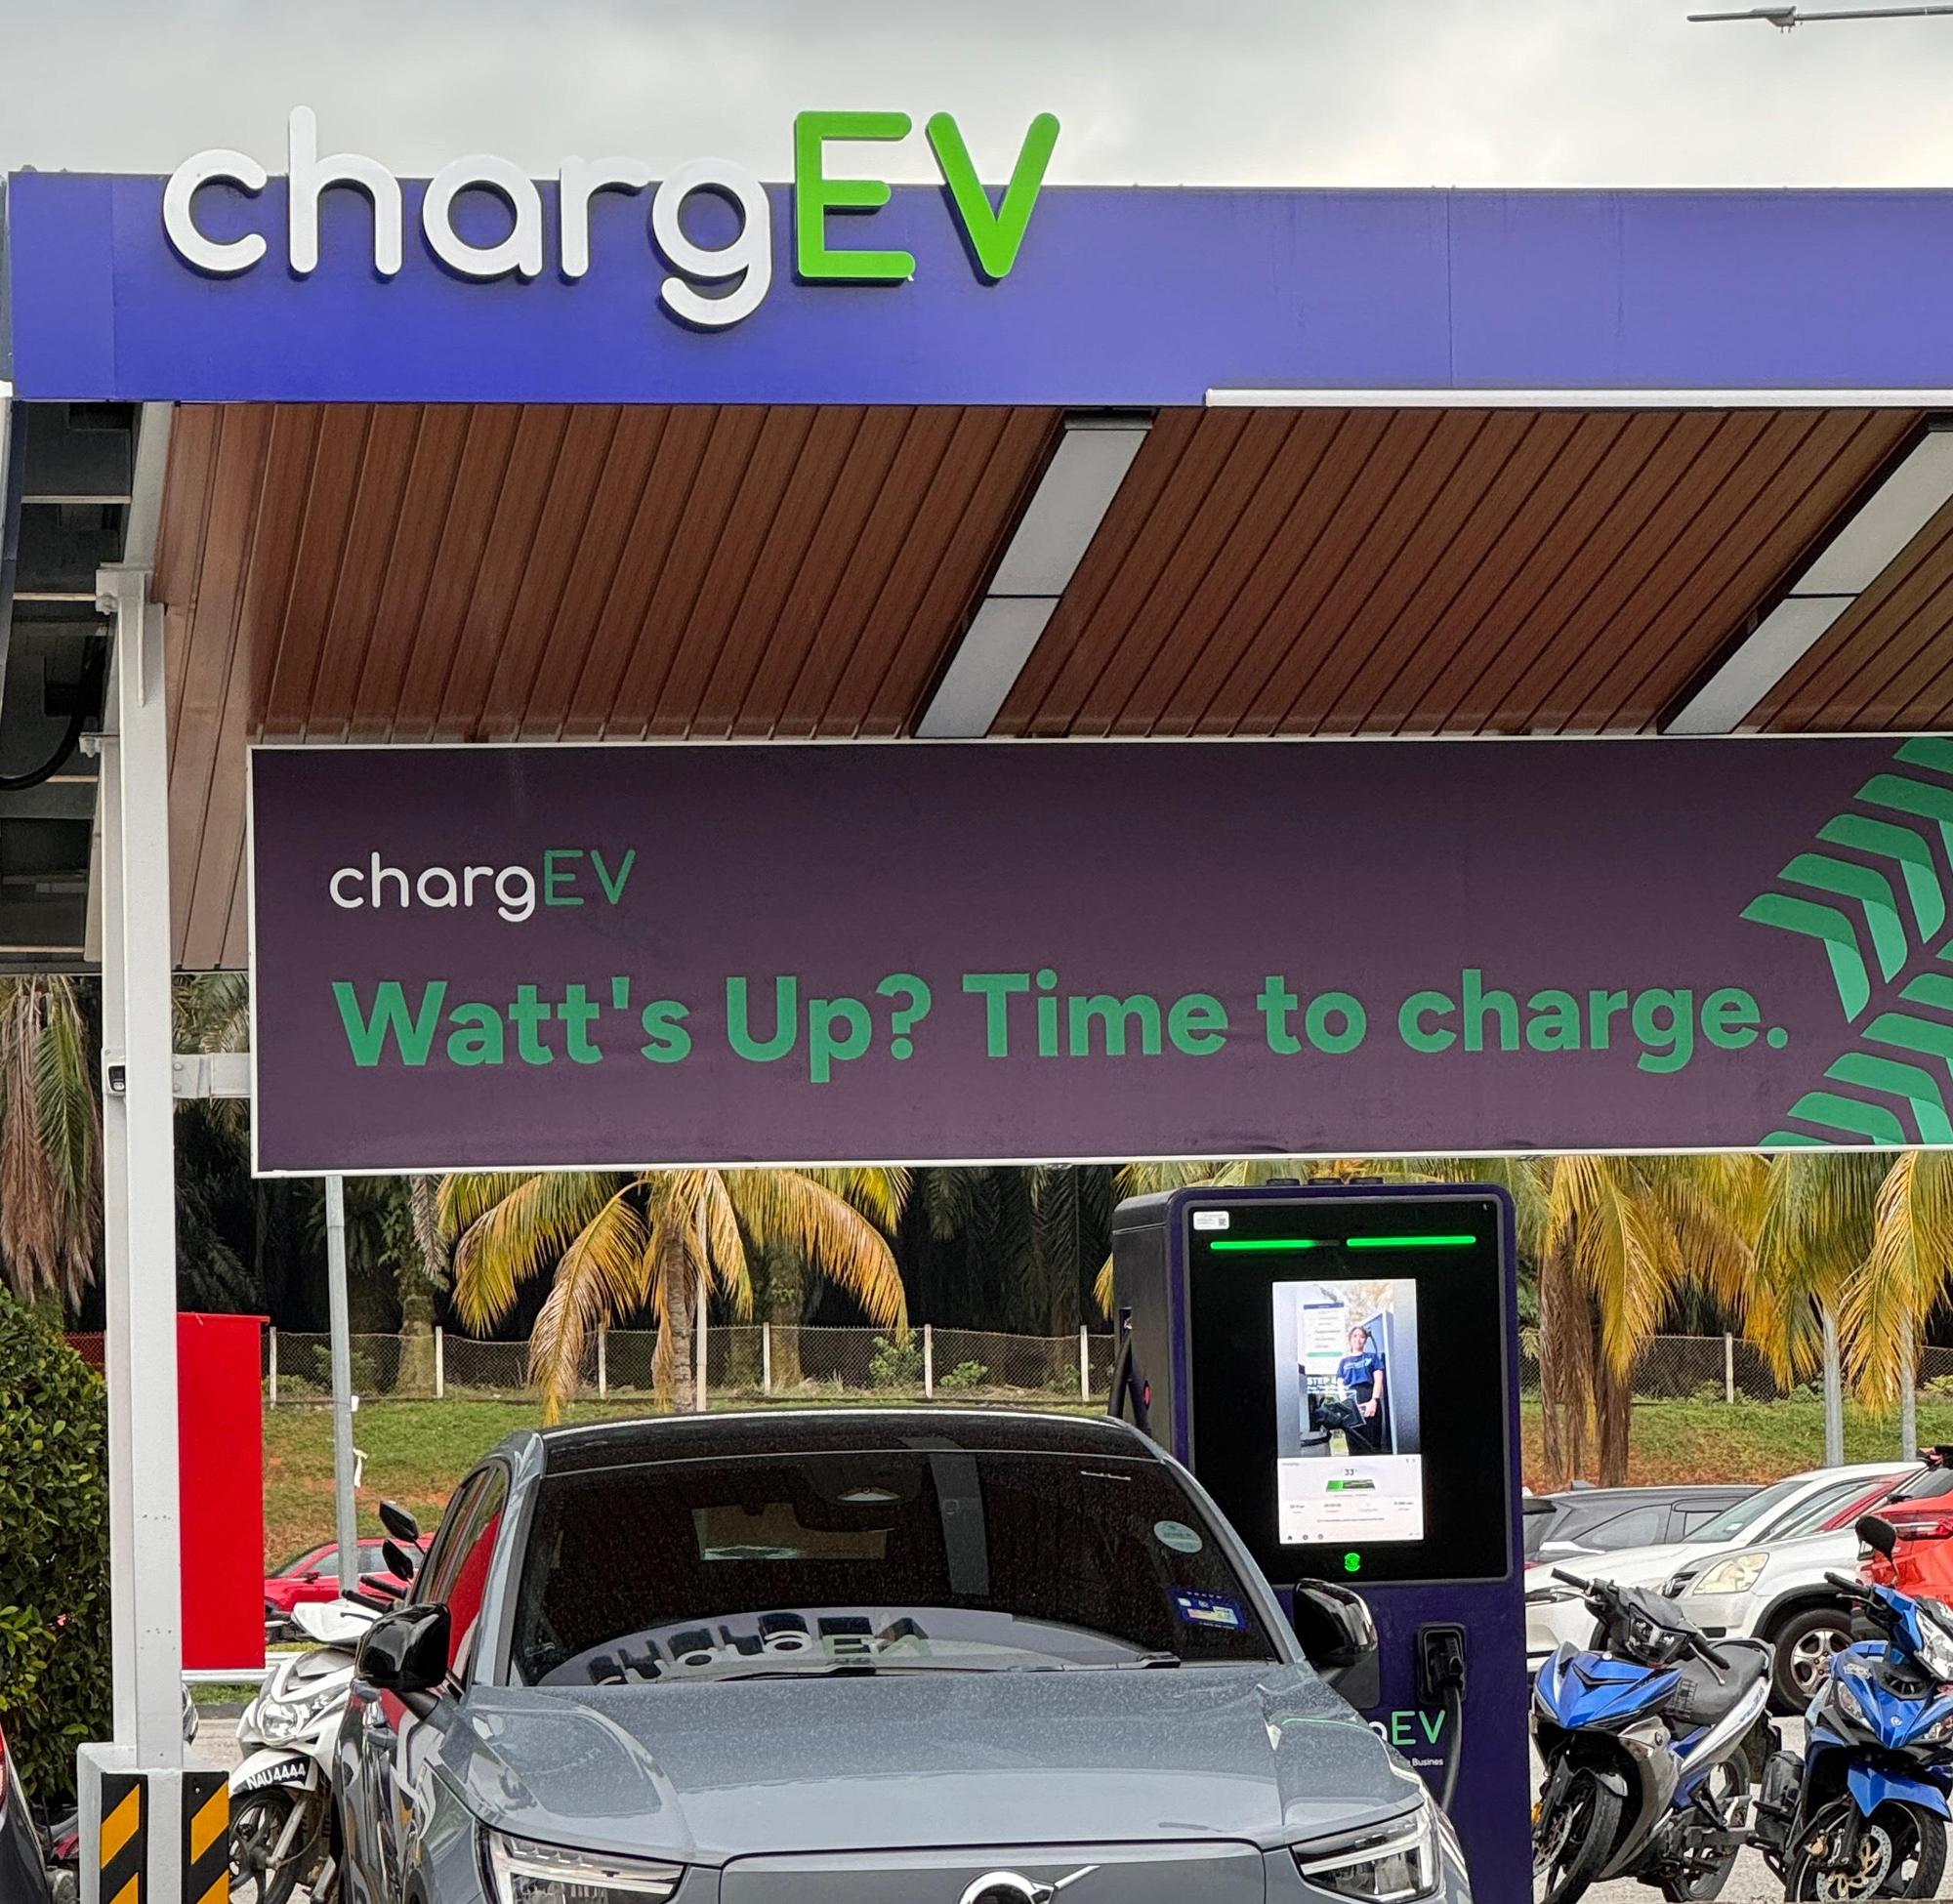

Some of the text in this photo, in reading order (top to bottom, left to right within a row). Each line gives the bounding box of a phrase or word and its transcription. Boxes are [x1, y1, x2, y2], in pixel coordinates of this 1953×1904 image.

[163, 104, 1060, 328] chargEV
[329, 849, 637, 923] chargEV
[333, 968, 1788, 1083] Watt's Up? Time to charge.
